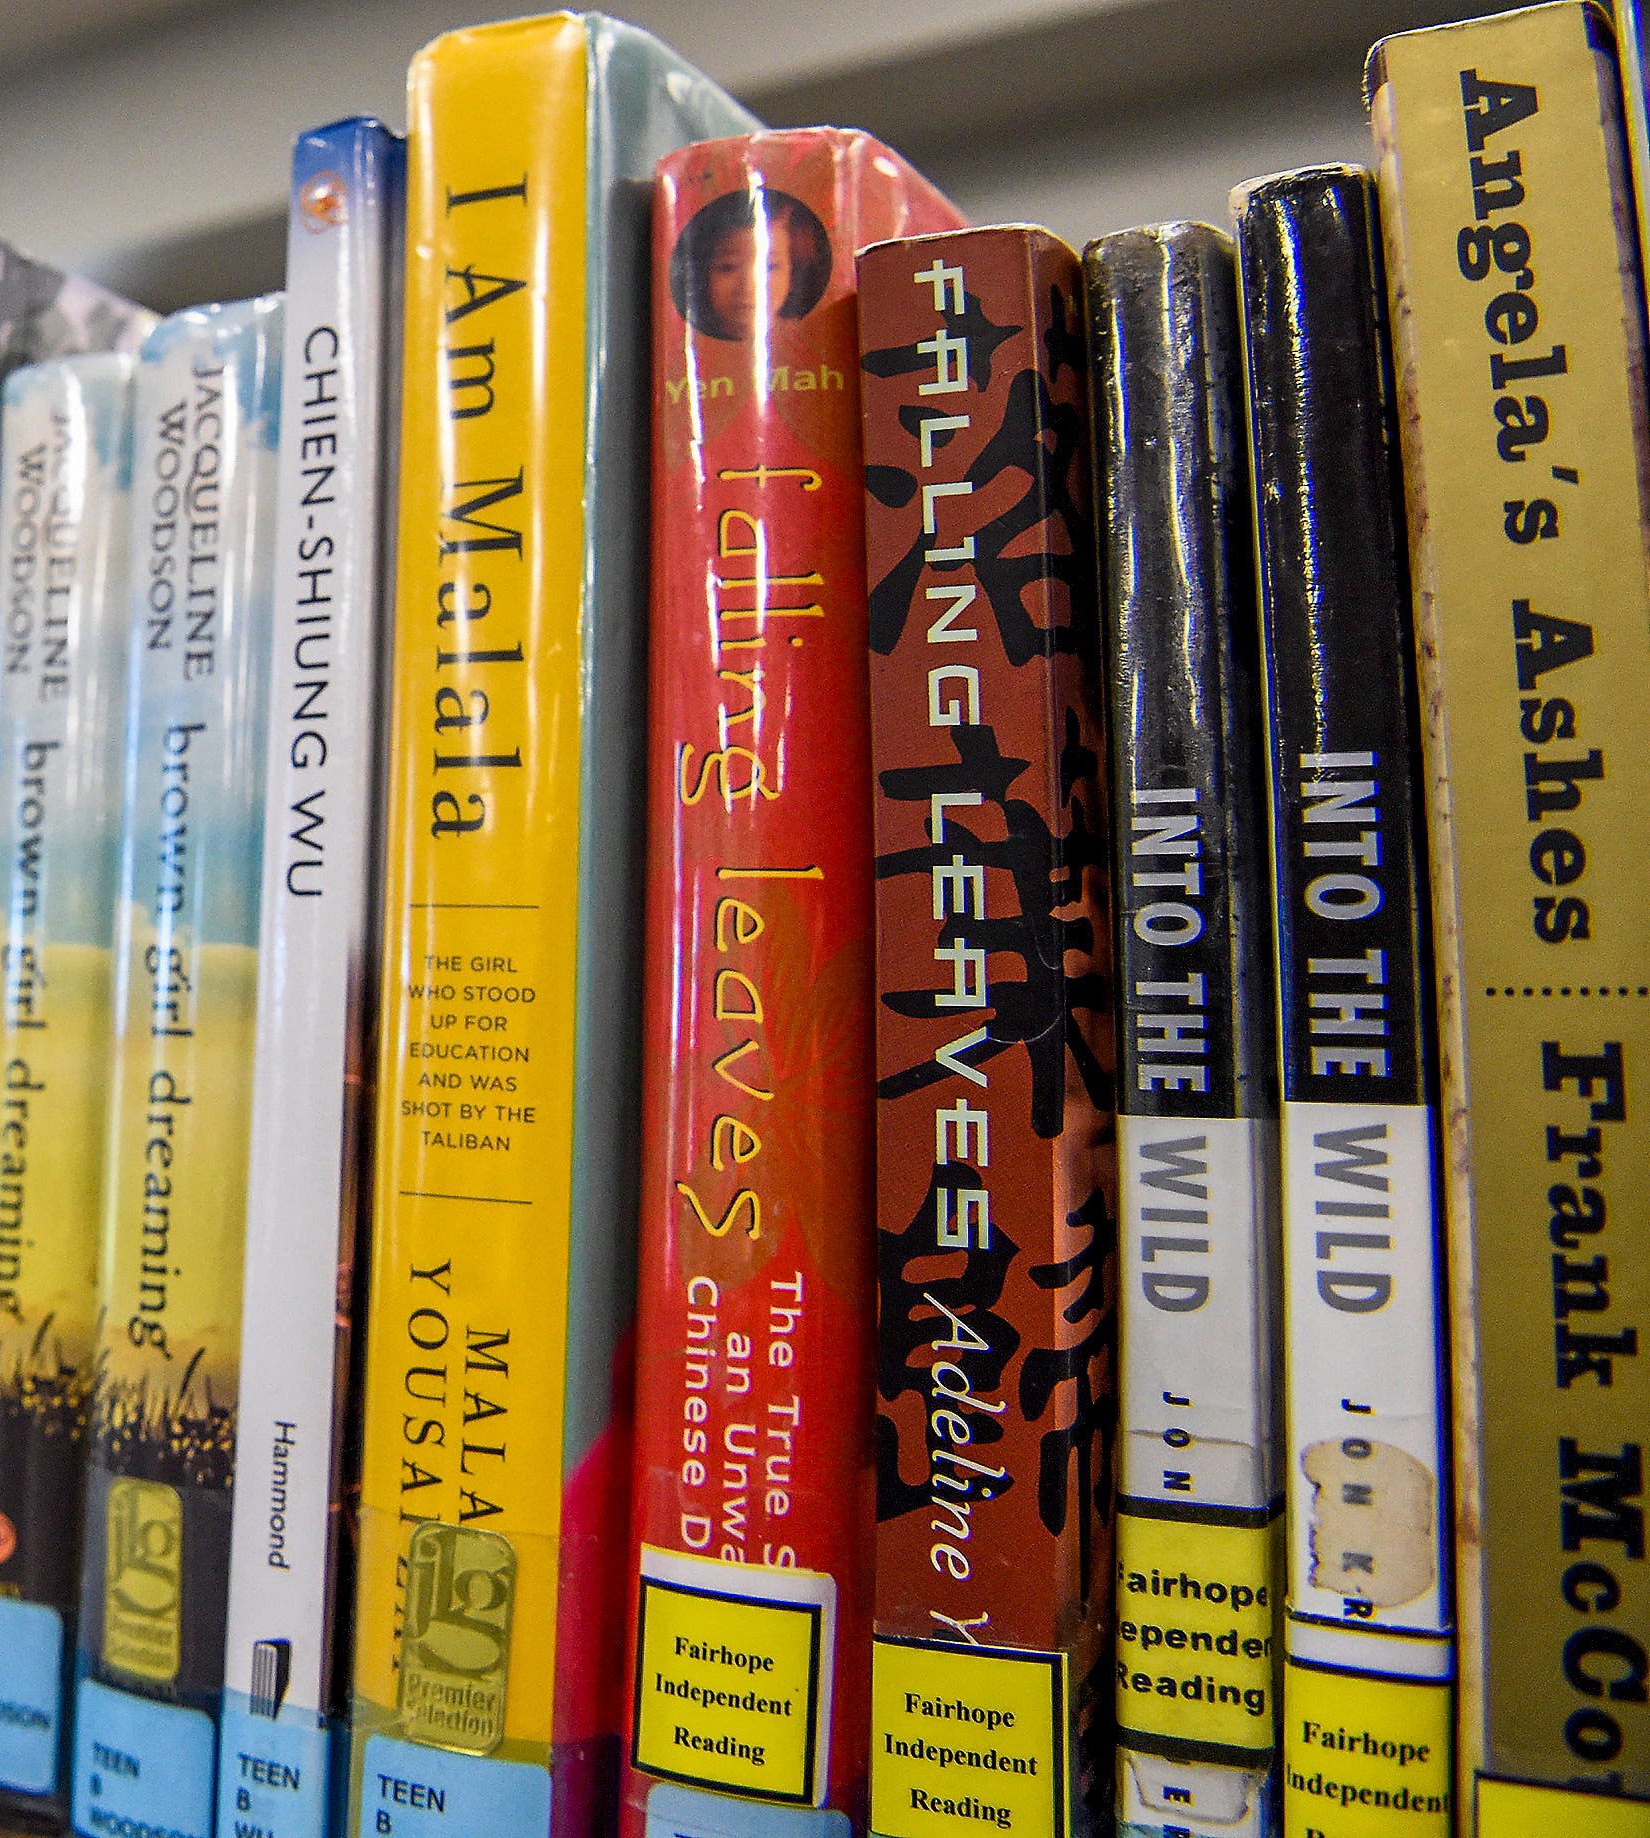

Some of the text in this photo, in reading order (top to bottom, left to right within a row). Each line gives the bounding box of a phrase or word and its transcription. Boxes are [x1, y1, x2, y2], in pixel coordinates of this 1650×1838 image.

[665, 372, 734, 403] Yen
[148, 401, 188, 651] WOODSON
[183, 357, 224, 682] JACQUELINE
[431, 174, 529, 839] I Am Malala
[1459, 68, 1605, 944] Angela's Ashes
[285, 326, 339, 896] CHIEN-SHIUNG WU
[914, 259, 991, 1251] FALLING LEAVES
[156, 723, 207, 916] brown
[677, 463, 825, 1240] falling leaves
[424, 954, 518, 974] THE GIRL
[1131, 787, 1211, 1093] INTO THE
[1300, 750, 1391, 1079] INTO THE
[408, 984, 536, 1004] WHO STOOD
[430, 1015, 508, 1033] UP FOR
[410, 1041, 530, 1064] EDUCATION
[419, 1072, 518, 1093] AND WAS
[402, 1100, 537, 1124] SHOT BY THE
[422, 1130, 511, 1152] TALIBAN
[128, 1069, 192, 1360] dreaming
[1139, 1134, 1210, 1313] WILD
[1314, 1123, 1393, 1314] WILD
[724, 1332, 752, 1393] an
[768, 1272, 804, 1369] The
[459, 1326, 510, 1524] MALA
[680, 1276, 719, 1488] Chinese
[1541, 1041, 1650, 1788] Frank McCo
[764, 1396, 803, 1518] True
[923, 1292, 1009, 1582] Adeline
[1162, 1391, 1191, 1492] JON
[1341, 1398, 1373, 1507] JON
[269, 1421, 297, 1571] Hammond
[654, 1673, 792, 1718] Independent
[673, 1634, 776, 1675] Fairhope
[672, 1725, 766, 1765] Reading
[882, 1733, 1039, 1777] Independent
[903, 1692, 1017, 1730] Fairhope
[1302, 1720, 1431, 1766] Fairhope
[237, 1752, 299, 1790] TEEN
[237, 1786, 251, 1812] B
[377, 1773, 445, 1813] TEEN
[908, 1787, 1013, 1830] Reading
[376, 1808, 392, 1835] B
